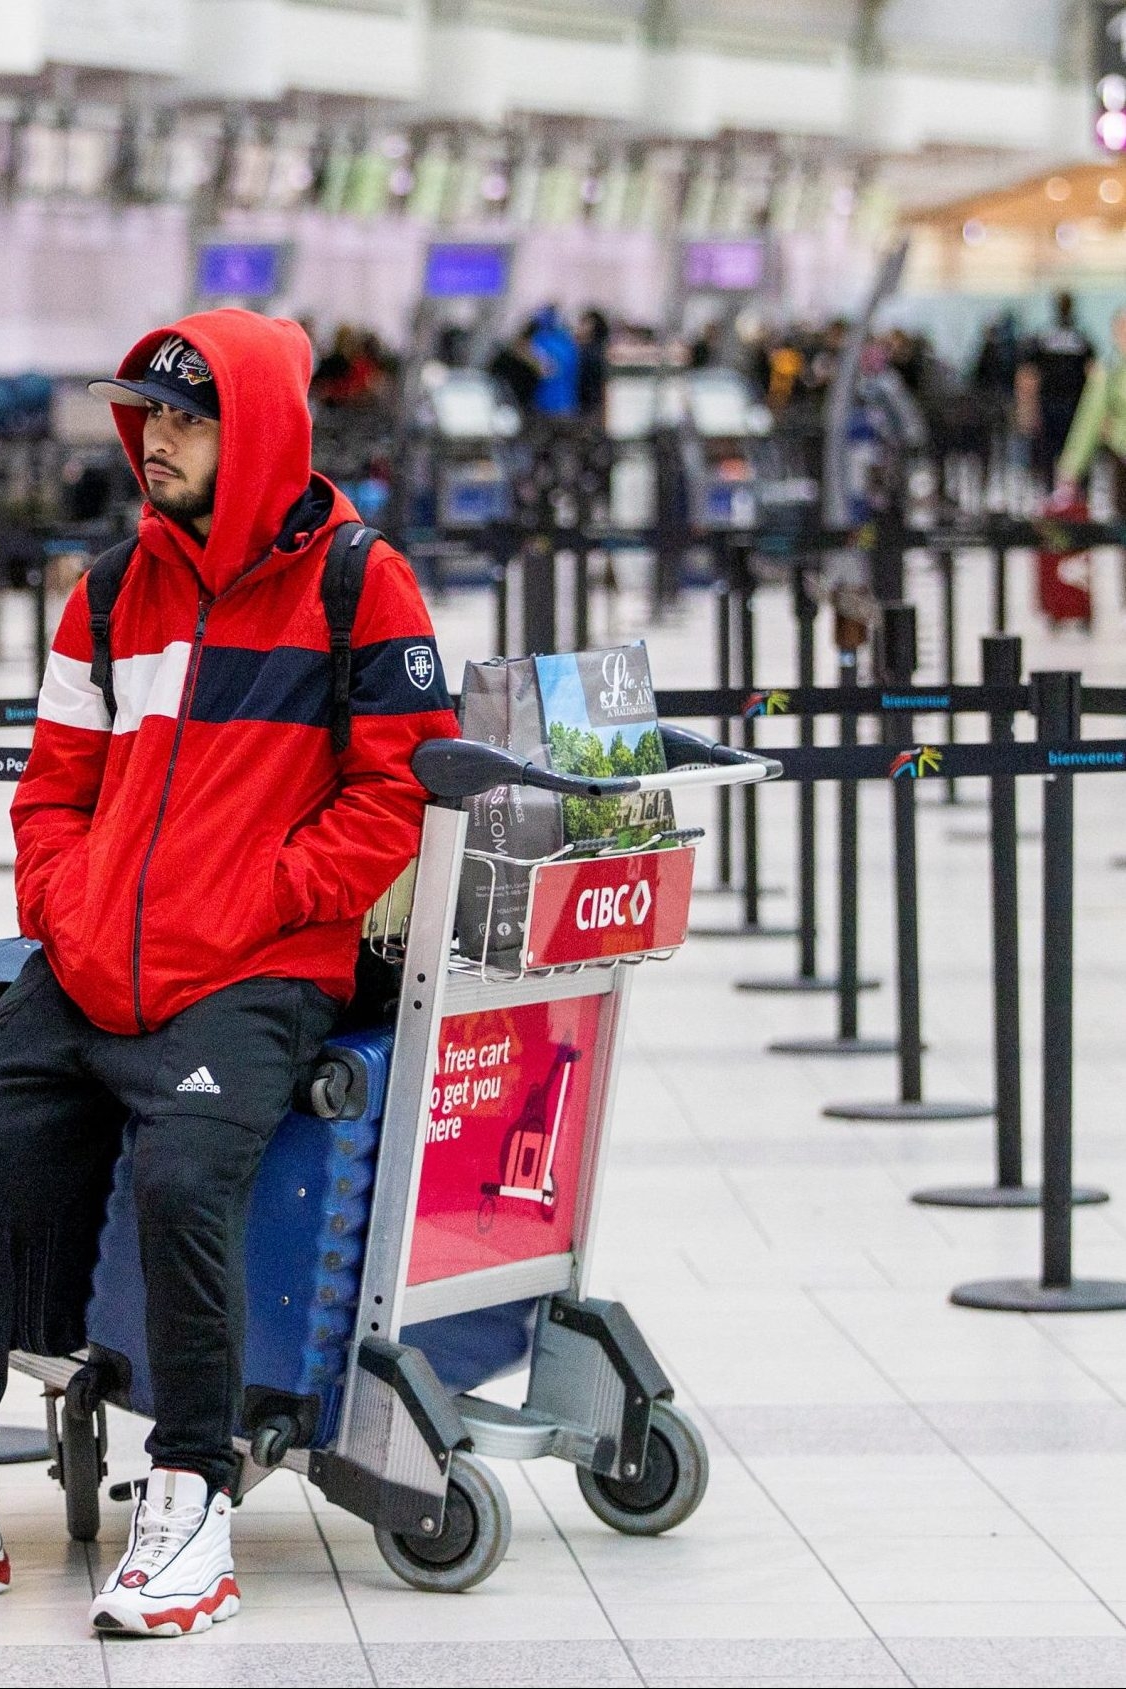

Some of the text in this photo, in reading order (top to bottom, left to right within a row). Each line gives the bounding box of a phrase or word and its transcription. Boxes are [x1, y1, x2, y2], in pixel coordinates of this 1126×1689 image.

[150, 335, 184, 372] NY
[5, 706, 38, 720] bienv
[882, 694, 950, 709] bienvenue
[1048, 751, 1124, 766] bienvenue
[489, 786, 509, 856] ES.COM
[512, 785, 525, 823] ERIENCES
[576, 884, 630, 931] CIBC
[444, 1042, 476, 1074] free
[479, 1035, 511, 1068] cart
[176, 1083, 221, 1094] adidas
[430, 1076, 502, 1115] o get you
[426, 1112, 462, 1144] here
